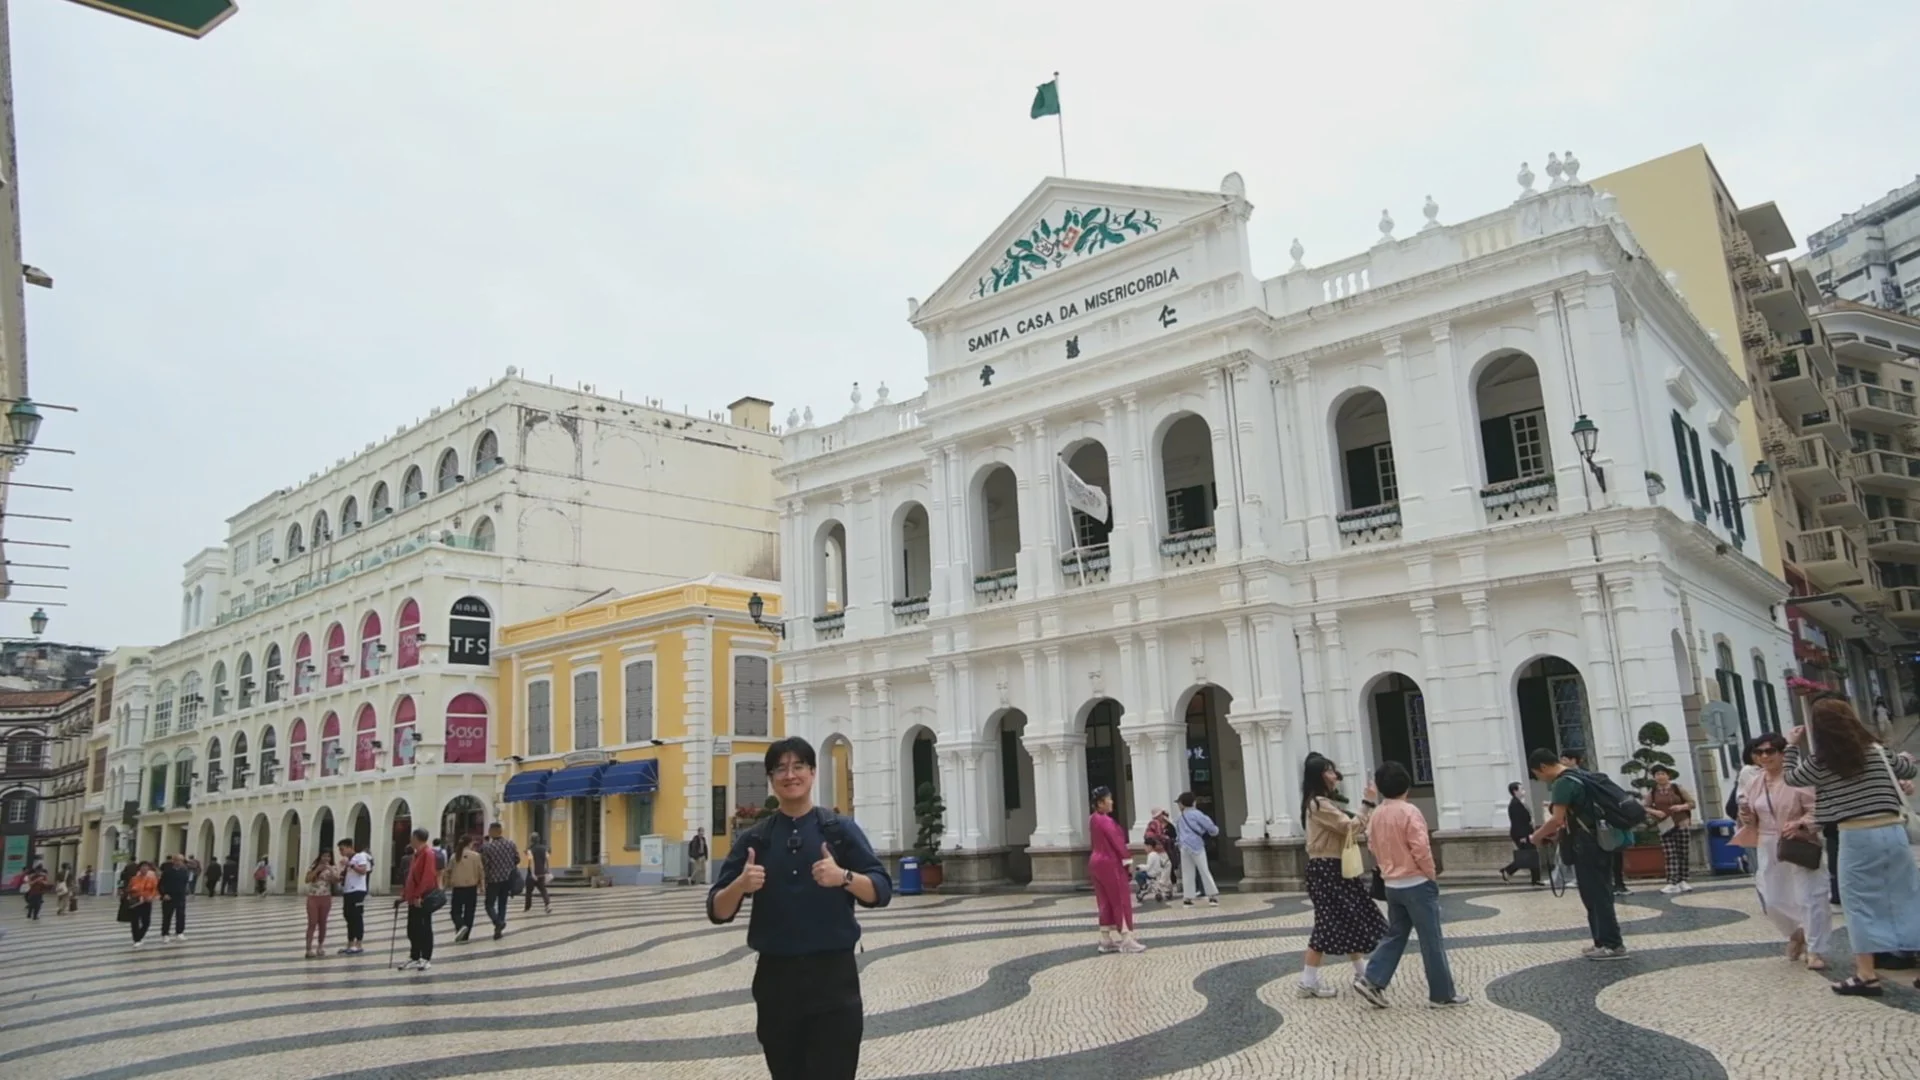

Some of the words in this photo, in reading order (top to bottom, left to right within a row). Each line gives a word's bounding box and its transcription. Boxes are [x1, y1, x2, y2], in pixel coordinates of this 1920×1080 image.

[968, 327, 1010, 352] SANTA
[1016, 311, 1054, 335] CASA
[1059, 302, 1079, 320] DA
[1084, 266, 1179, 312] MISERICORDIA
[451, 636, 487, 655] TFS
[448, 724, 484, 739] Sasa
